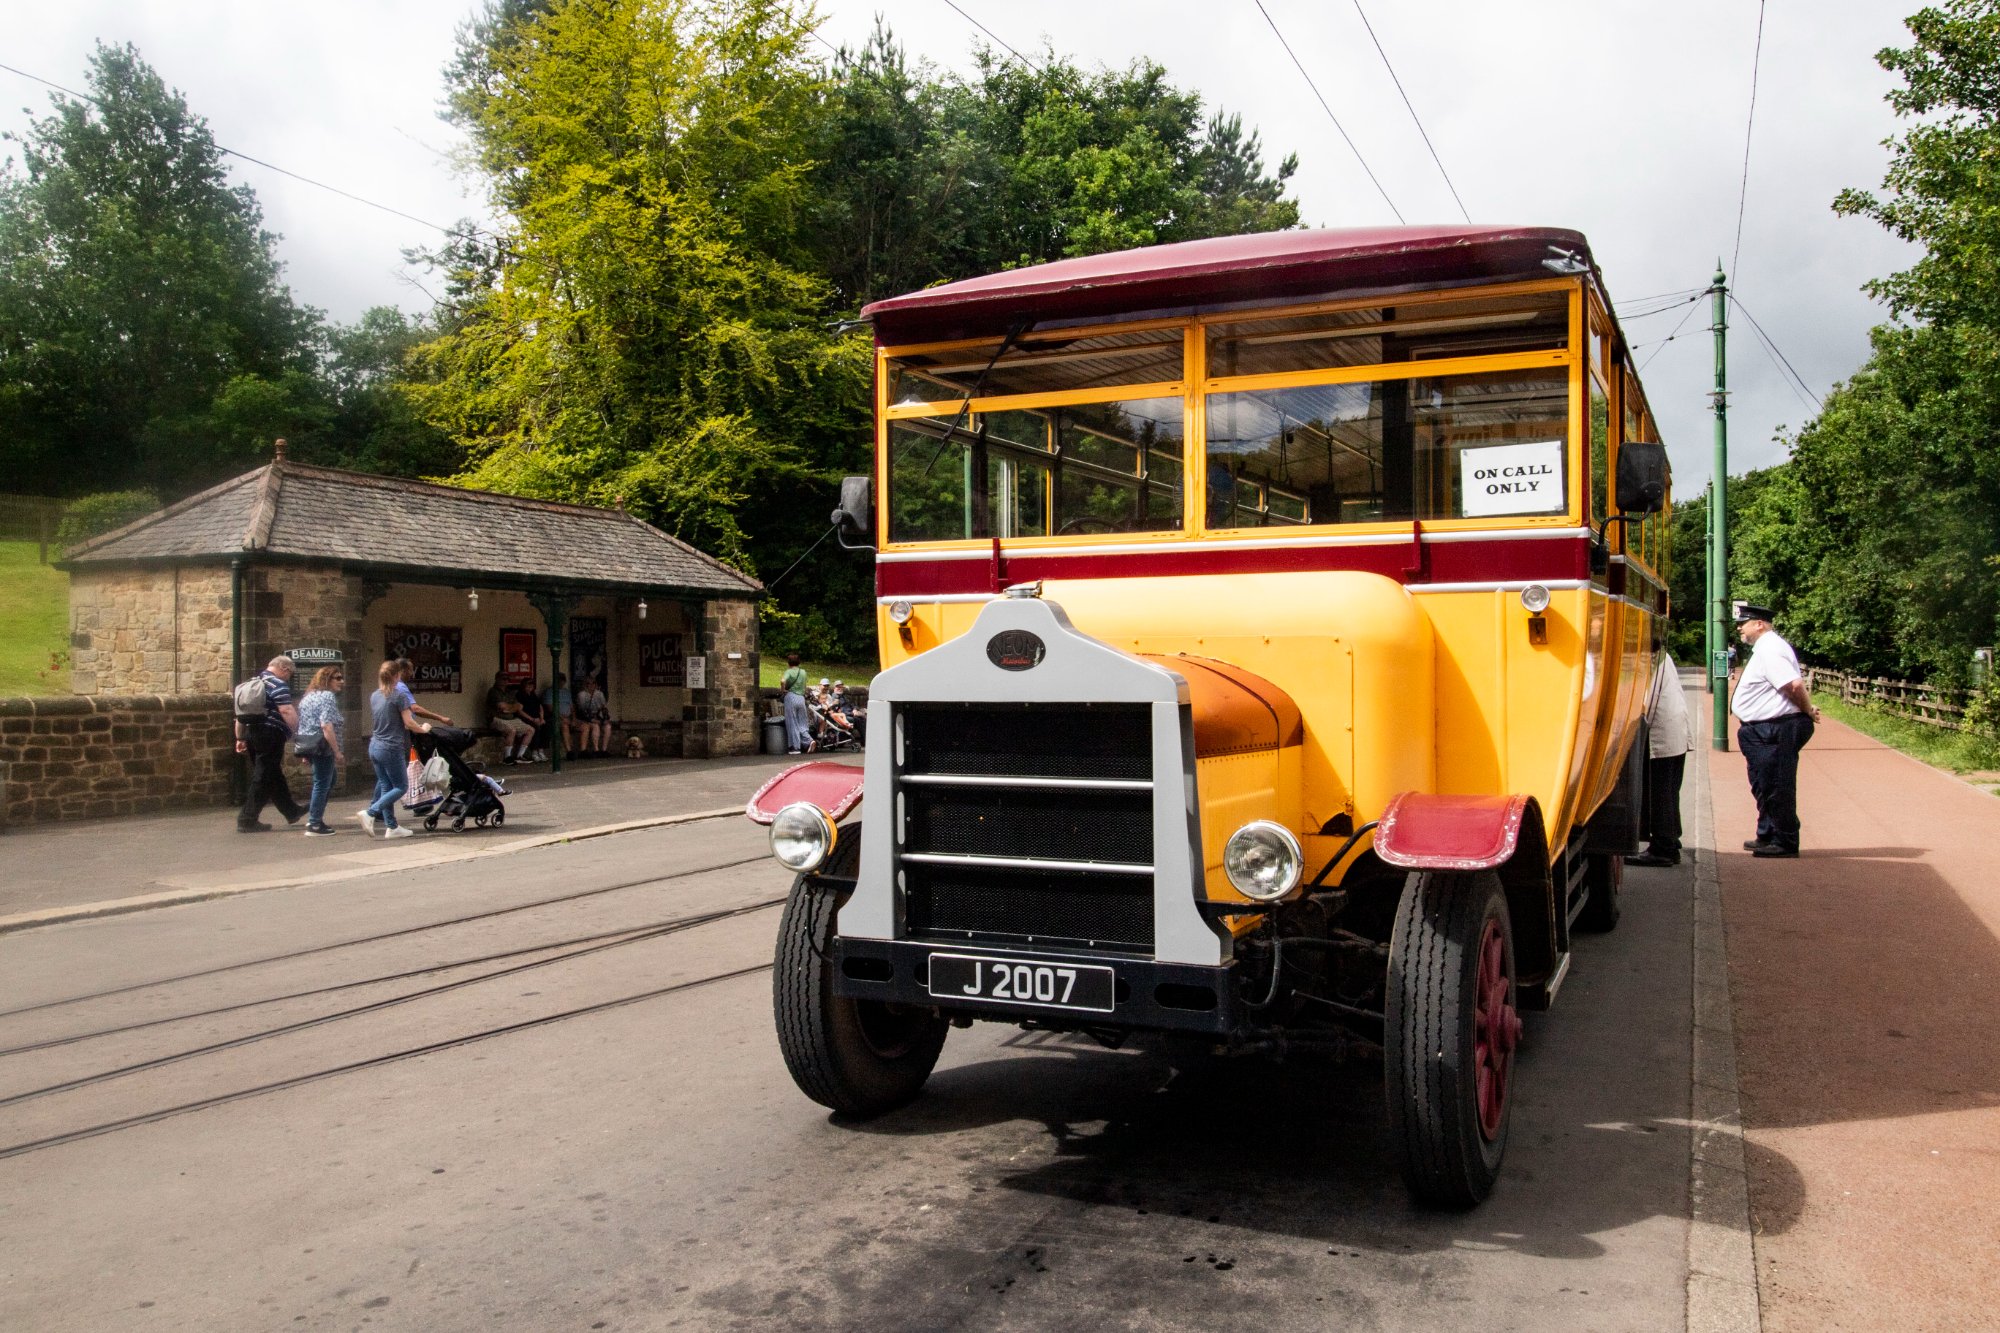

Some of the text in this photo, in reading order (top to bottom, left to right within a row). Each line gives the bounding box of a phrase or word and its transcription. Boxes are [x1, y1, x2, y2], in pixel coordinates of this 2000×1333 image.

[1474, 465, 1552, 480] ON CALL
[1486, 481, 1540, 494] ONLY
[393, 632, 455, 660] BORAX
[291, 649, 336, 660] BEAMISH
[421, 666, 452, 679] SOAP
[963, 962, 1077, 1003] J 2007
